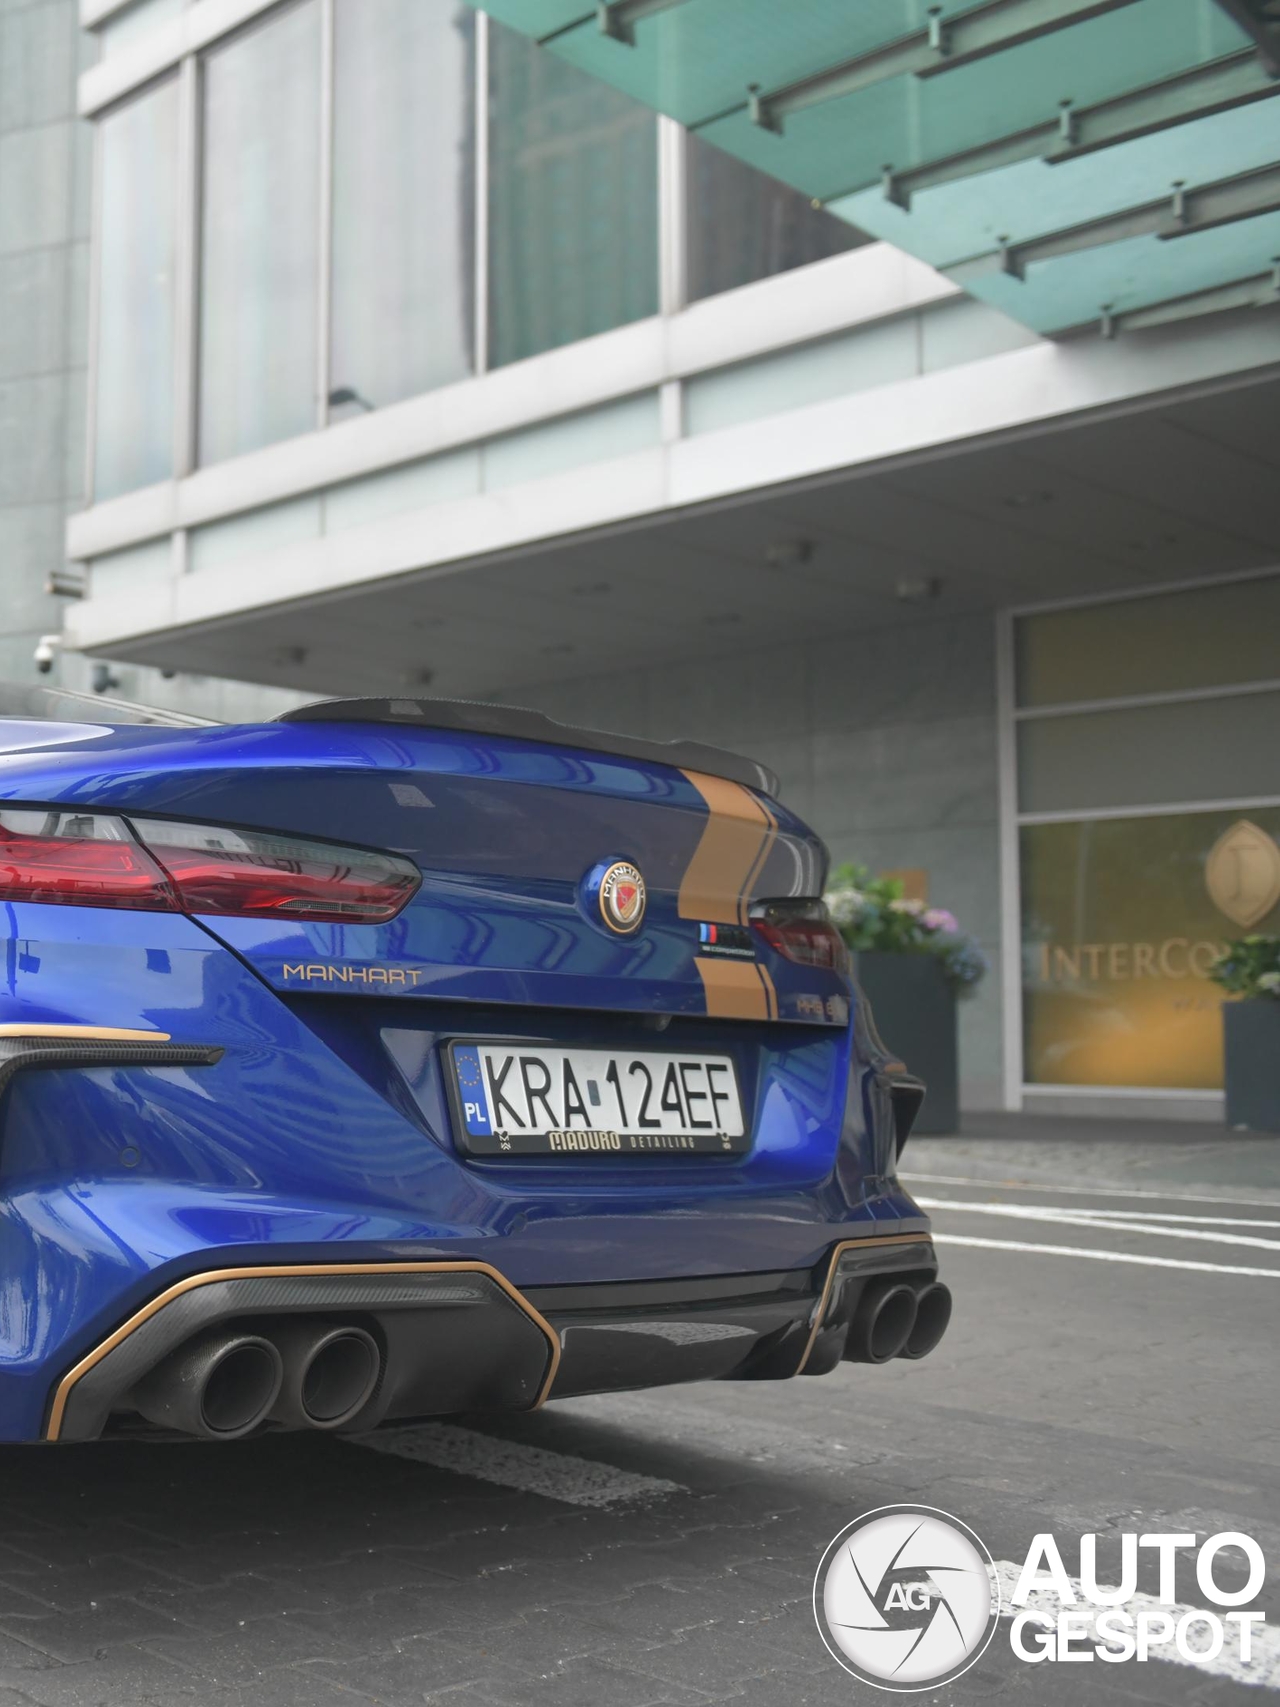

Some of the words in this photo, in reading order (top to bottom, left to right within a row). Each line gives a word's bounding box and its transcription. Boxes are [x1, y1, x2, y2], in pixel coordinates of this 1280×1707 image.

[603, 866, 645, 898] MANHART
[1040, 938, 1232, 982] INTERCO
[283, 964, 422, 985] MANHART
[485, 1056, 591, 1128] KRA
[605, 1060, 729, 1129] 124EF
[465, 1102, 486, 1122] PL
[549, 1131, 621, 1150] MADURO
[630, 1136, 695, 1149] DETAILING
